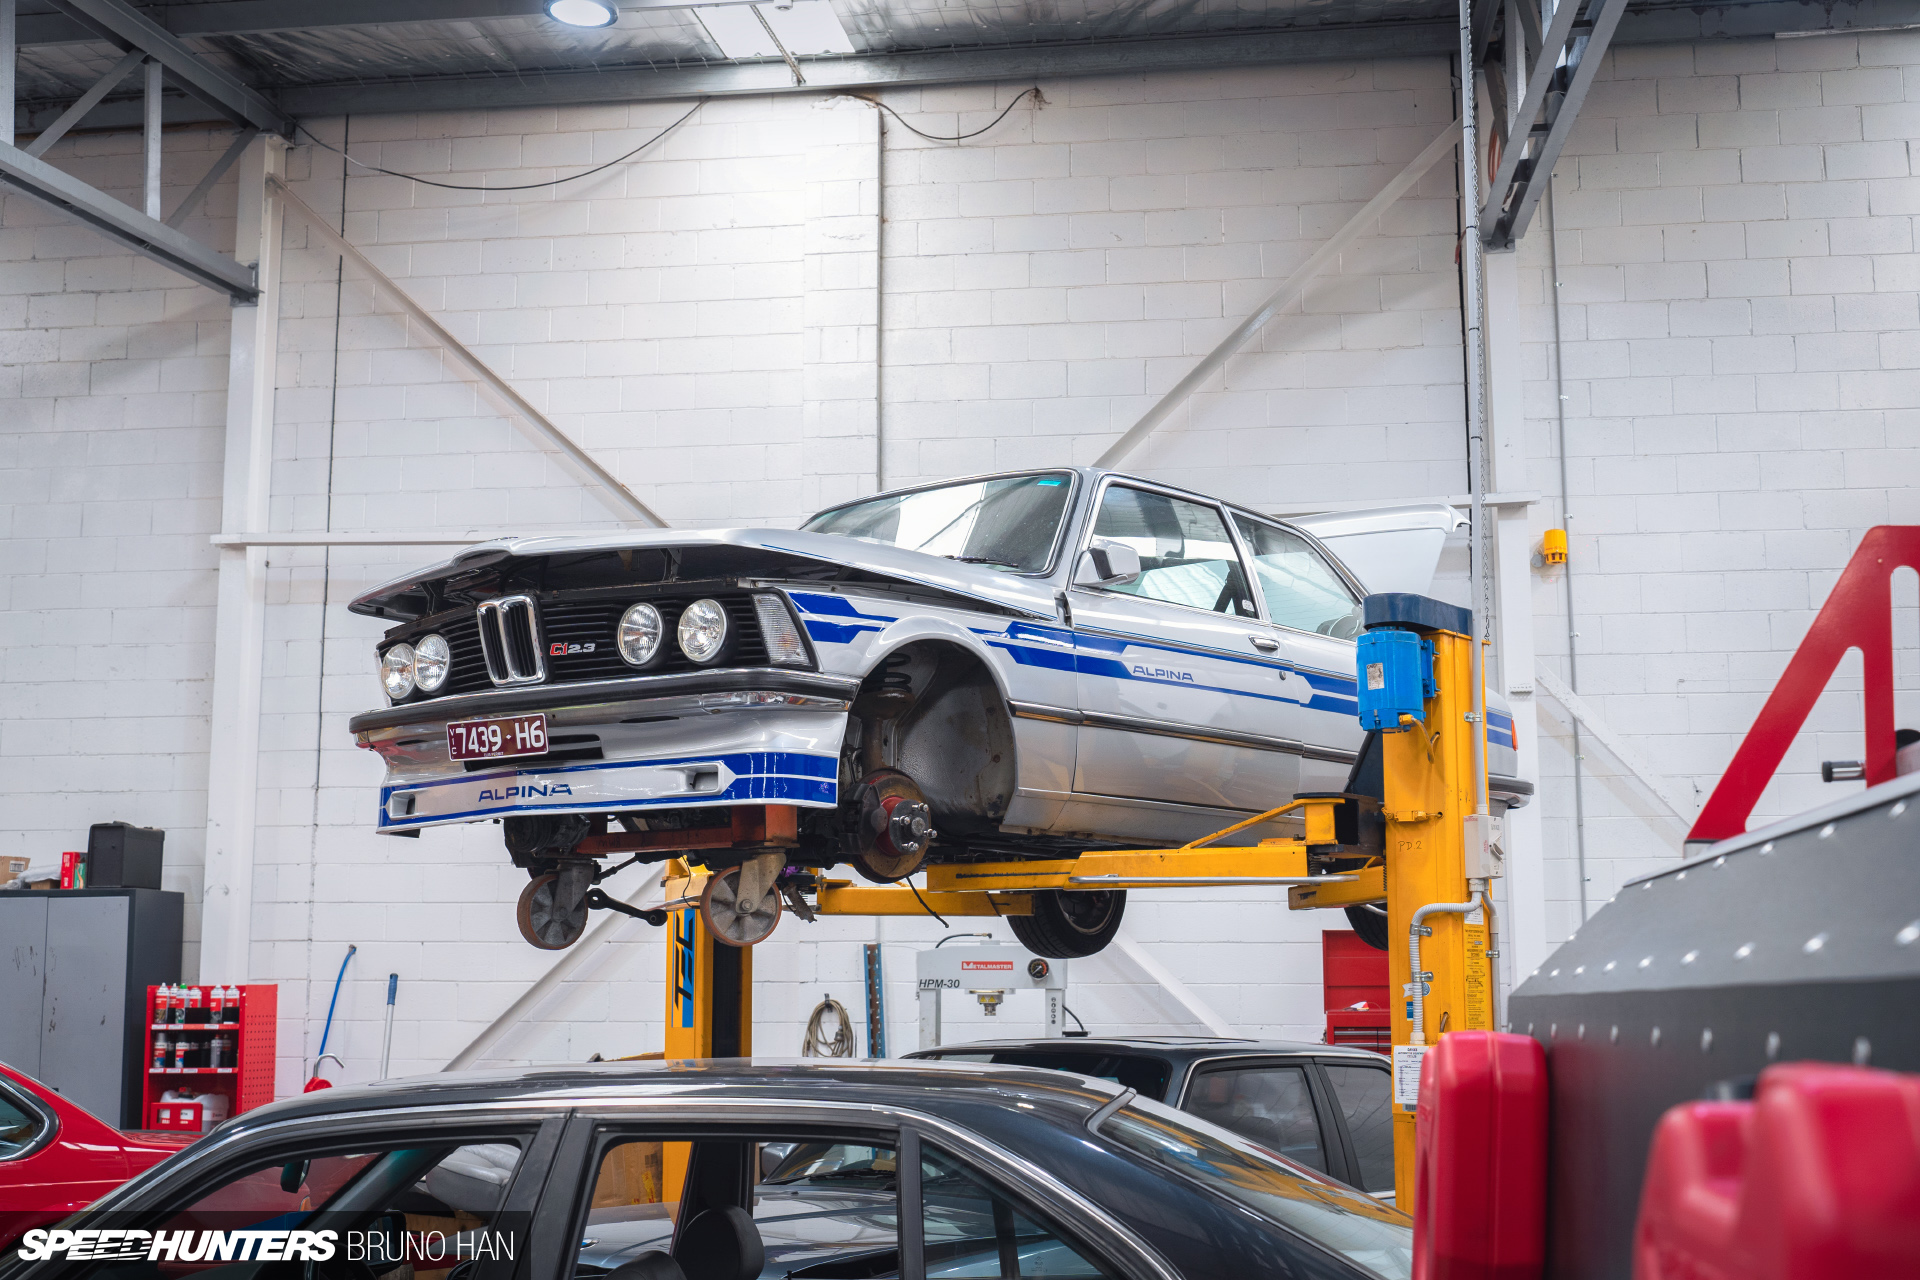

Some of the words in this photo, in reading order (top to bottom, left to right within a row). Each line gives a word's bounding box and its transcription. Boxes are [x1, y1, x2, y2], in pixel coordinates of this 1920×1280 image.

[1132, 665, 1195, 683] ALPINA
[449, 728, 458, 755] VIC
[478, 783, 573, 803] ALPINA
[962, 962, 1012, 970] METALMASTER
[918, 979, 961, 989] HPM-30
